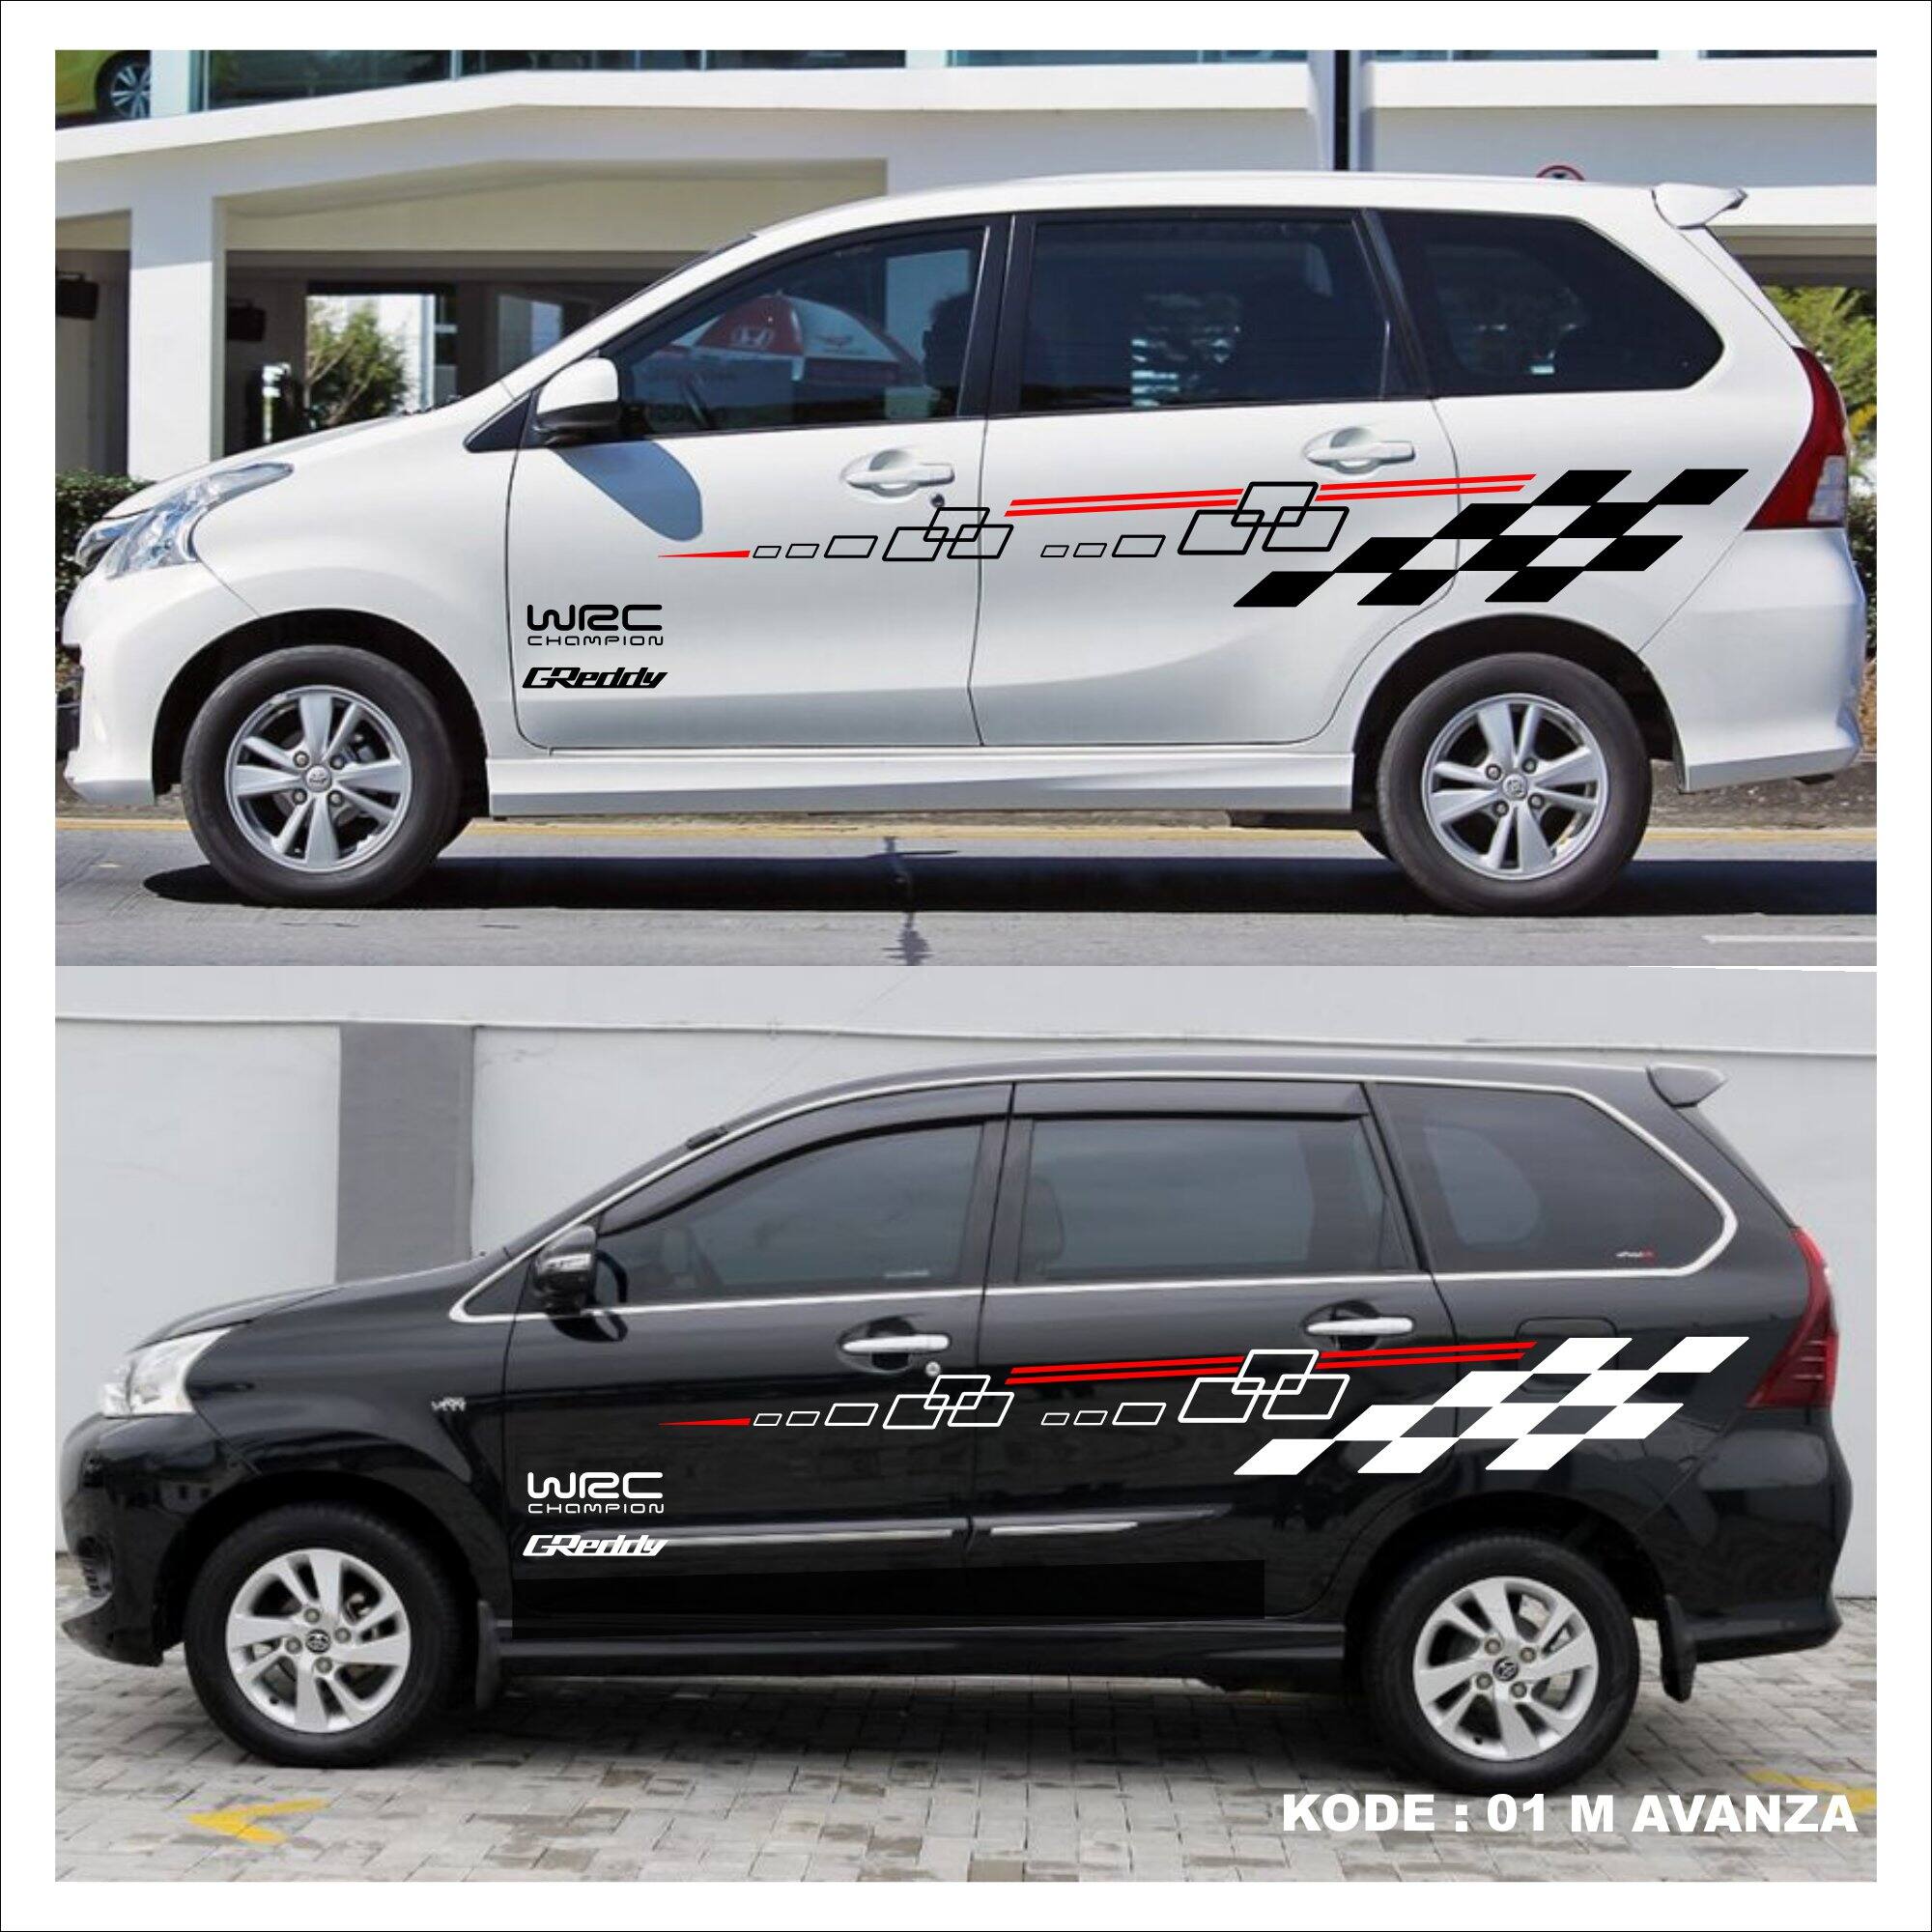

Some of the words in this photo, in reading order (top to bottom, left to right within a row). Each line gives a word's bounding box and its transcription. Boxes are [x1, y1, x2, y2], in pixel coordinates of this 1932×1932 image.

[526, 604, 663, 632] WRC
[522, 667, 668, 689] GReddy
[526, 1471, 664, 1499] WRC
[523, 1534, 669, 1557] GReddy
